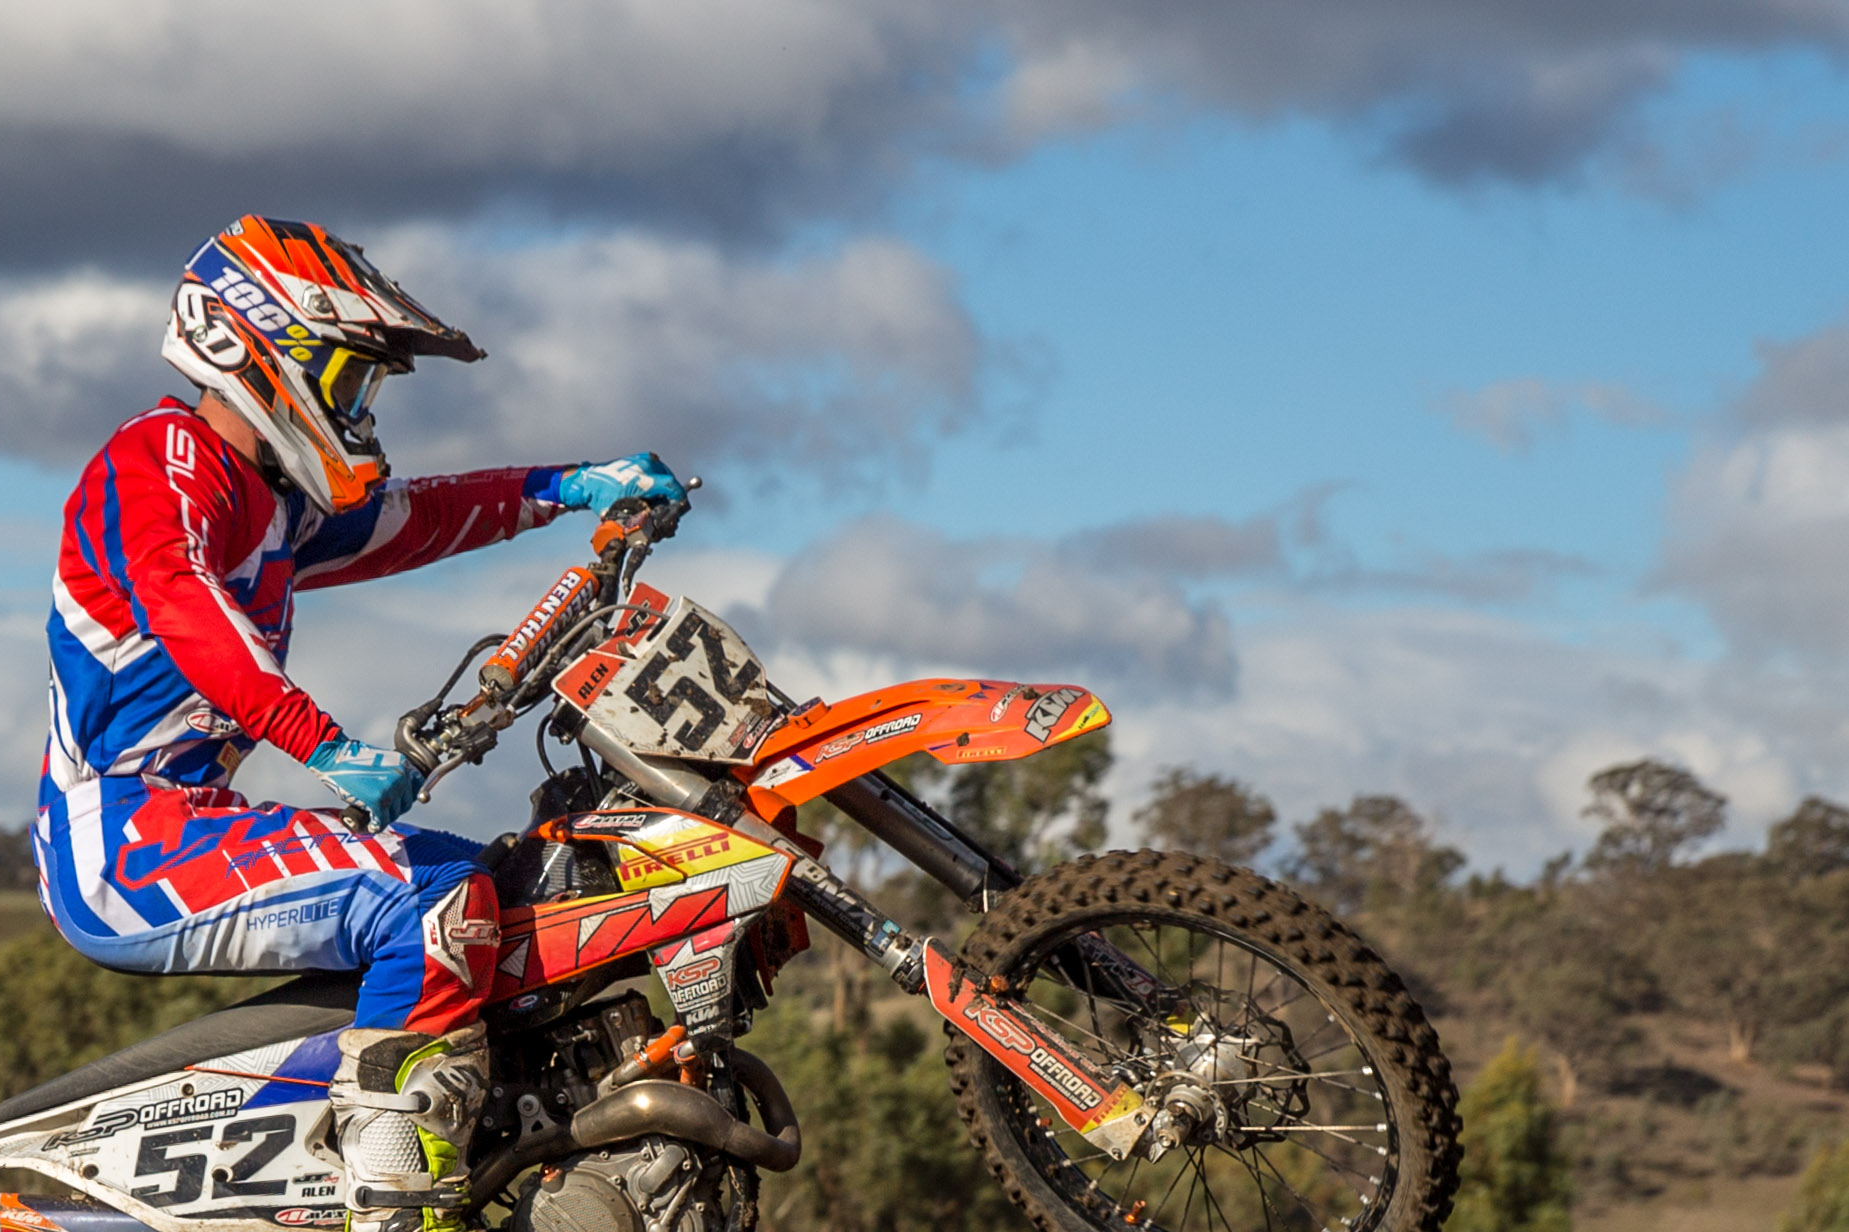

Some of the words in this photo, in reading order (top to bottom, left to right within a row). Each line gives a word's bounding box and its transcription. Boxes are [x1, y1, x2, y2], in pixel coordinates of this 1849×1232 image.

[210, 266, 324, 362] 100%
[499, 571, 582, 661] RENTHAL
[577, 663, 609, 700] ALEN
[624, 611, 761, 751] 52
[865, 713, 922, 740] OFFROAD
[1024, 687, 1087, 744] KTM
[619, 832, 731, 882] PIRELLI
[246, 898, 340, 932] HYPERLITE
[666, 956, 722, 991] KSP
[671, 974, 728, 1004] OFFROAD
[686, 1004, 721, 1026] KTM
[963, 1002, 1037, 1055] KSP
[1030, 1047, 1103, 1110] OFFROAD
[42, 1108, 139, 1151] KSP
[139, 1089, 242, 1124] OFFROAD
[131, 1113, 297, 1206] 52
[301, 1186, 336, 1198] ALEN
[0, 1210, 43, 1225] KTM
